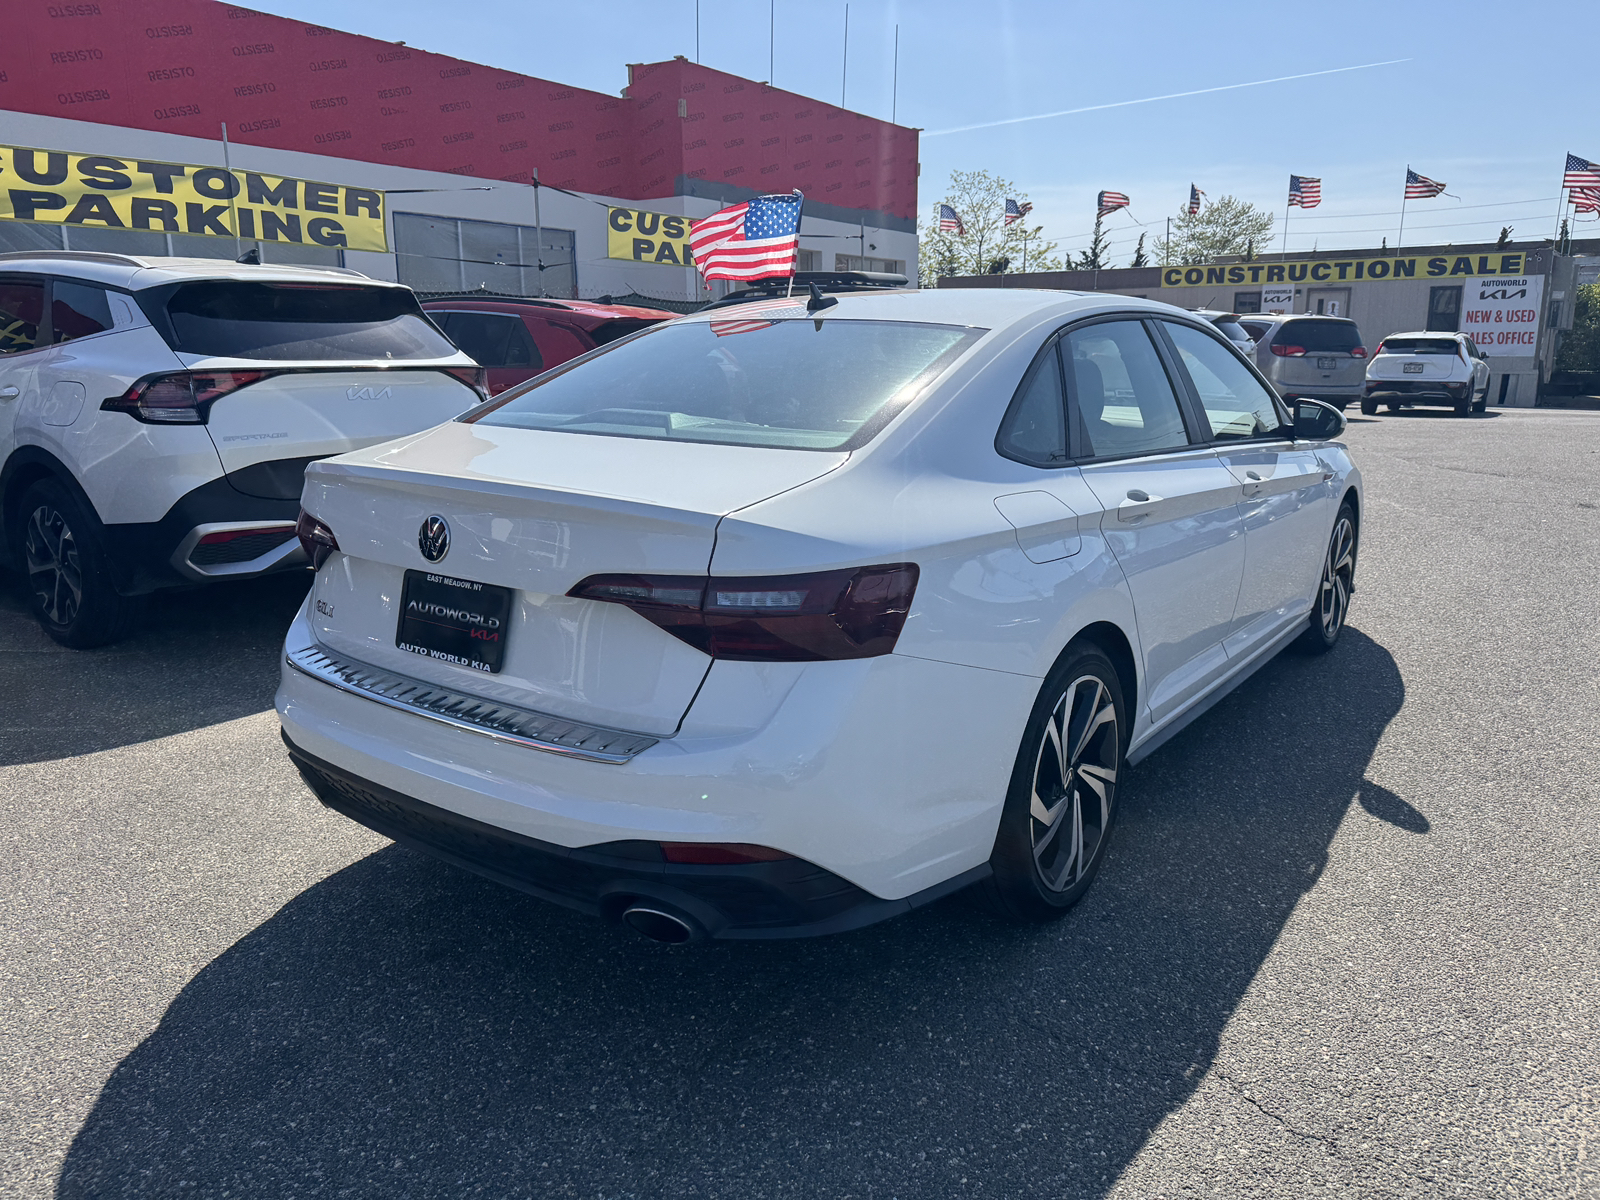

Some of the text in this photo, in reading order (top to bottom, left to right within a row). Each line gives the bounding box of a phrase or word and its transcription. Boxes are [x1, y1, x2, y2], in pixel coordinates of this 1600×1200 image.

[227, 9, 271, 20] RESIS
[146, 25, 193, 39] RESISTO
[305, 27, 339, 37] RESIS
[51, 48, 103, 64] RESISTO
[233, 43, 274, 57] RESISTO
[309, 59, 348, 72] RESISTO
[147, 67, 195, 82] RESISTO
[58, 89, 110, 105] RESISTO
[234, 82, 276, 98] RESISTO
[377, 86, 412, 100] RESISTO
[310, 96, 348, 110] RESISTO
[439, 100, 472, 113] RESISTO
[154, 104, 201, 120] RESISTO
[496, 111, 526, 124] RESISTO
[239, 118, 281, 134] RESISTO
[314, 129, 352, 144] RESISTO
[381, 138, 415, 152] RESISTO
[687, 168, 707, 179] ESISTO
[0, 147, 382, 220] USTOMER
[8, 189, 349, 248] PARKING
[609, 208, 691, 239] CUS
[1163, 254, 1522, 286] CONSTRUCTION SALE
[1481, 279, 1528, 288] AUTOWORLD
[1479, 289, 1527, 300] KIA
[1466, 309, 1536, 323] NEW & USED
[1463, 331, 1535, 345] ALES OFFICE
[346, 385, 393, 401] KIA
[223, 432, 288, 442] SPORTAGE
[426, 573, 442, 585] EAST
[473, 583, 483, 592] NY
[407, 600, 500, 630] AUTOWORLD
[471, 628, 499, 643] KIA
[399, 642, 491, 673] AUTO WORLD KIA
